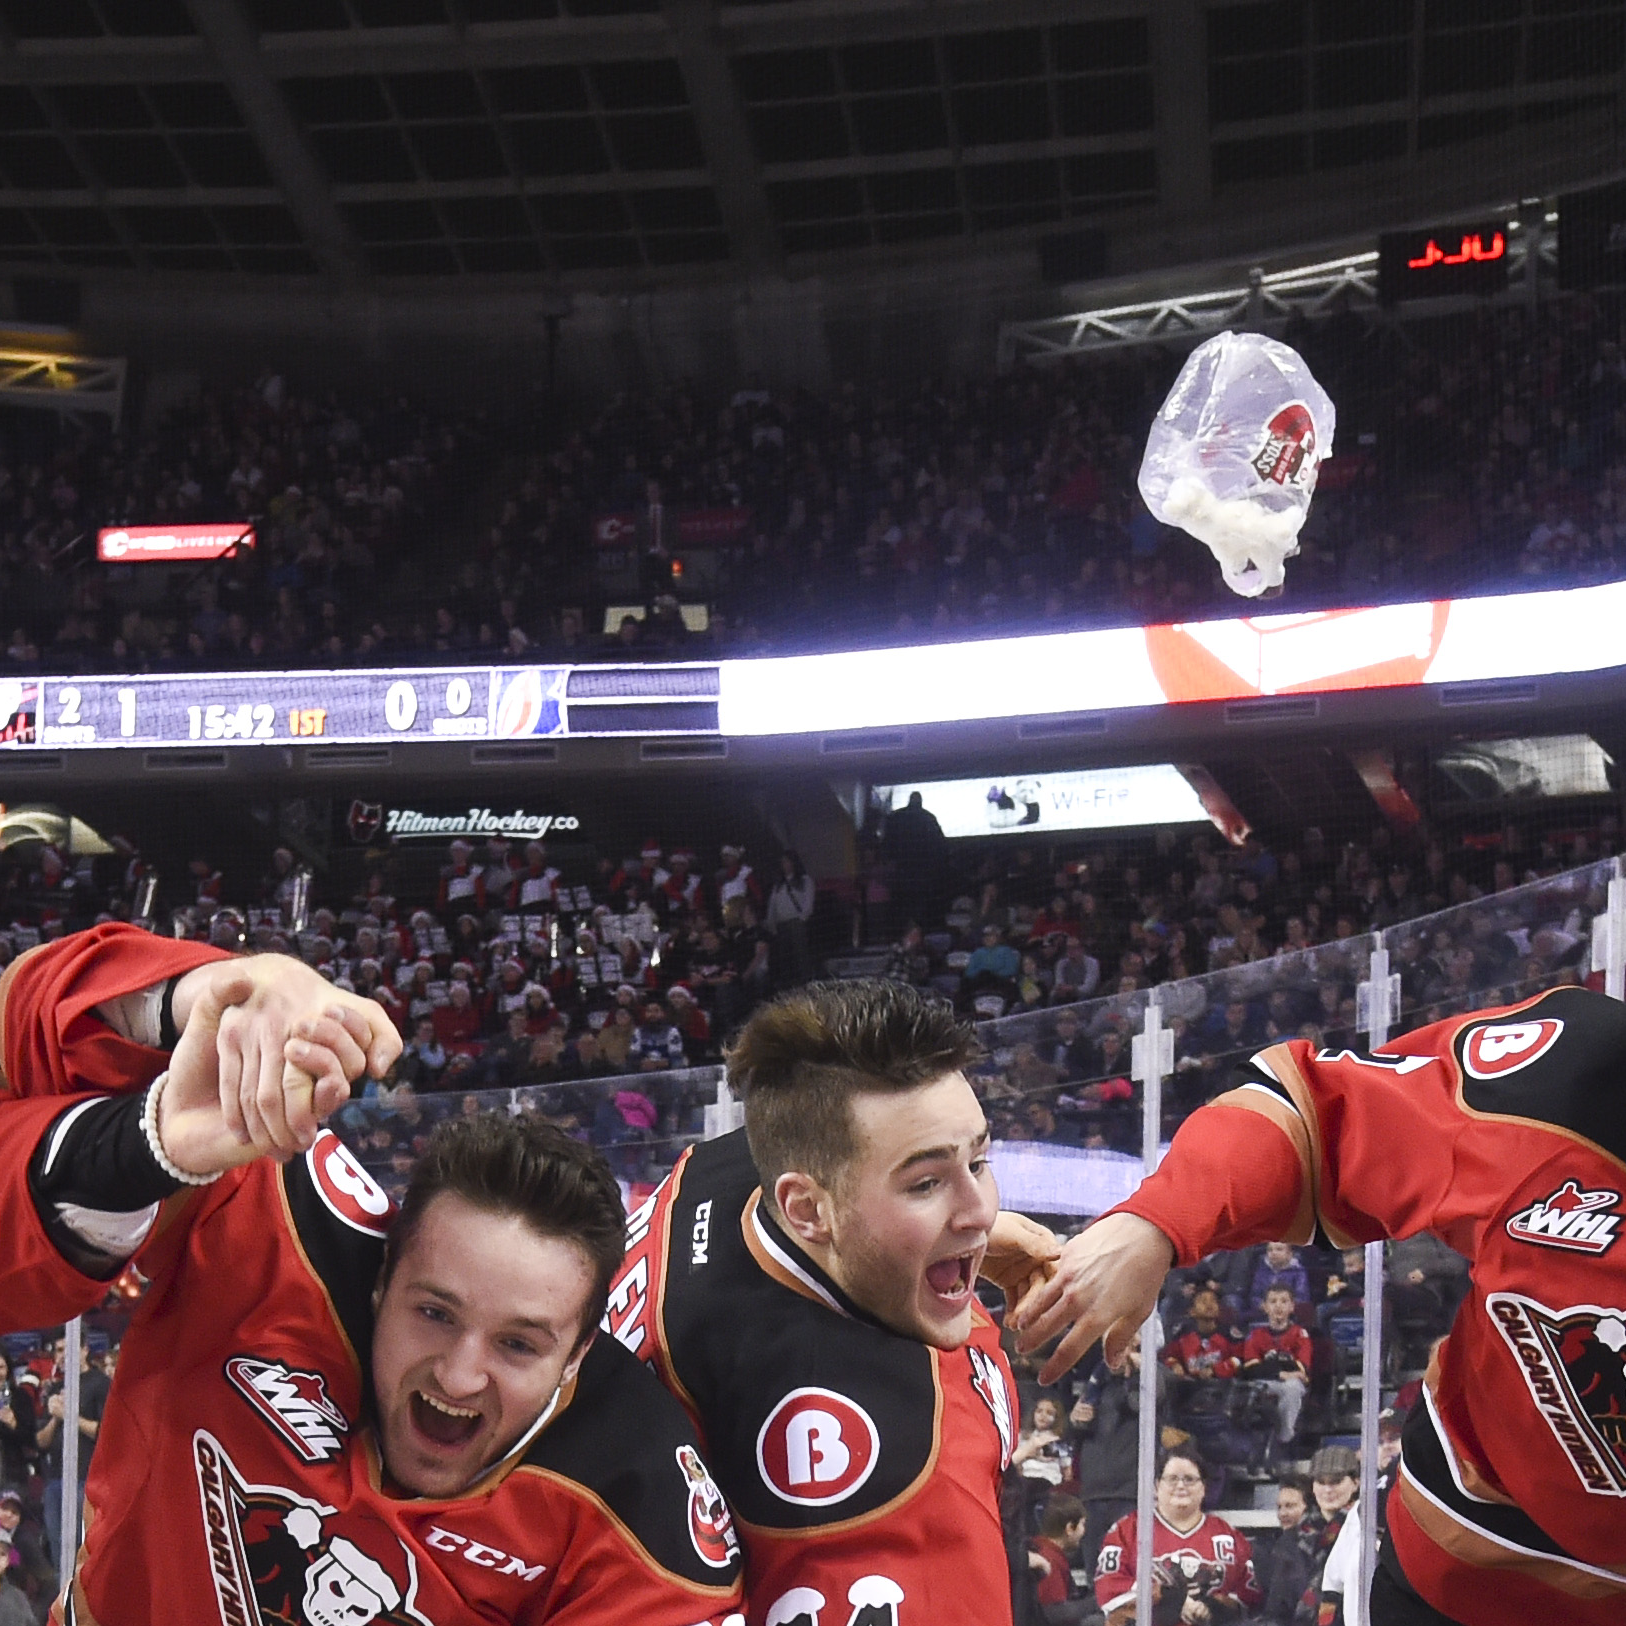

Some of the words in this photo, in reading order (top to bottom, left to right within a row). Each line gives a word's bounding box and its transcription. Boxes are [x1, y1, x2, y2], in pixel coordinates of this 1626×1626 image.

[58, 686, 83, 724] 2
[117, 687, 137, 738] 1
[187, 704, 275, 740] 15:42
[289, 708, 327, 736] 1ST
[384, 681, 418, 731] 0
[445, 677, 471, 716] 0
[690, 1199, 713, 1265] CCM
[1528, 1203, 1622, 1253] WHL
[246, 1363, 343, 1461] WHL
[1491, 1299, 1565, 1413] CALGARY
[1547, 1408, 1613, 1491] HITMEN
[785, 1409, 851, 1486] B
[195, 1438, 241, 1594] CALGARY
[425, 1525, 547, 1583] CCM
